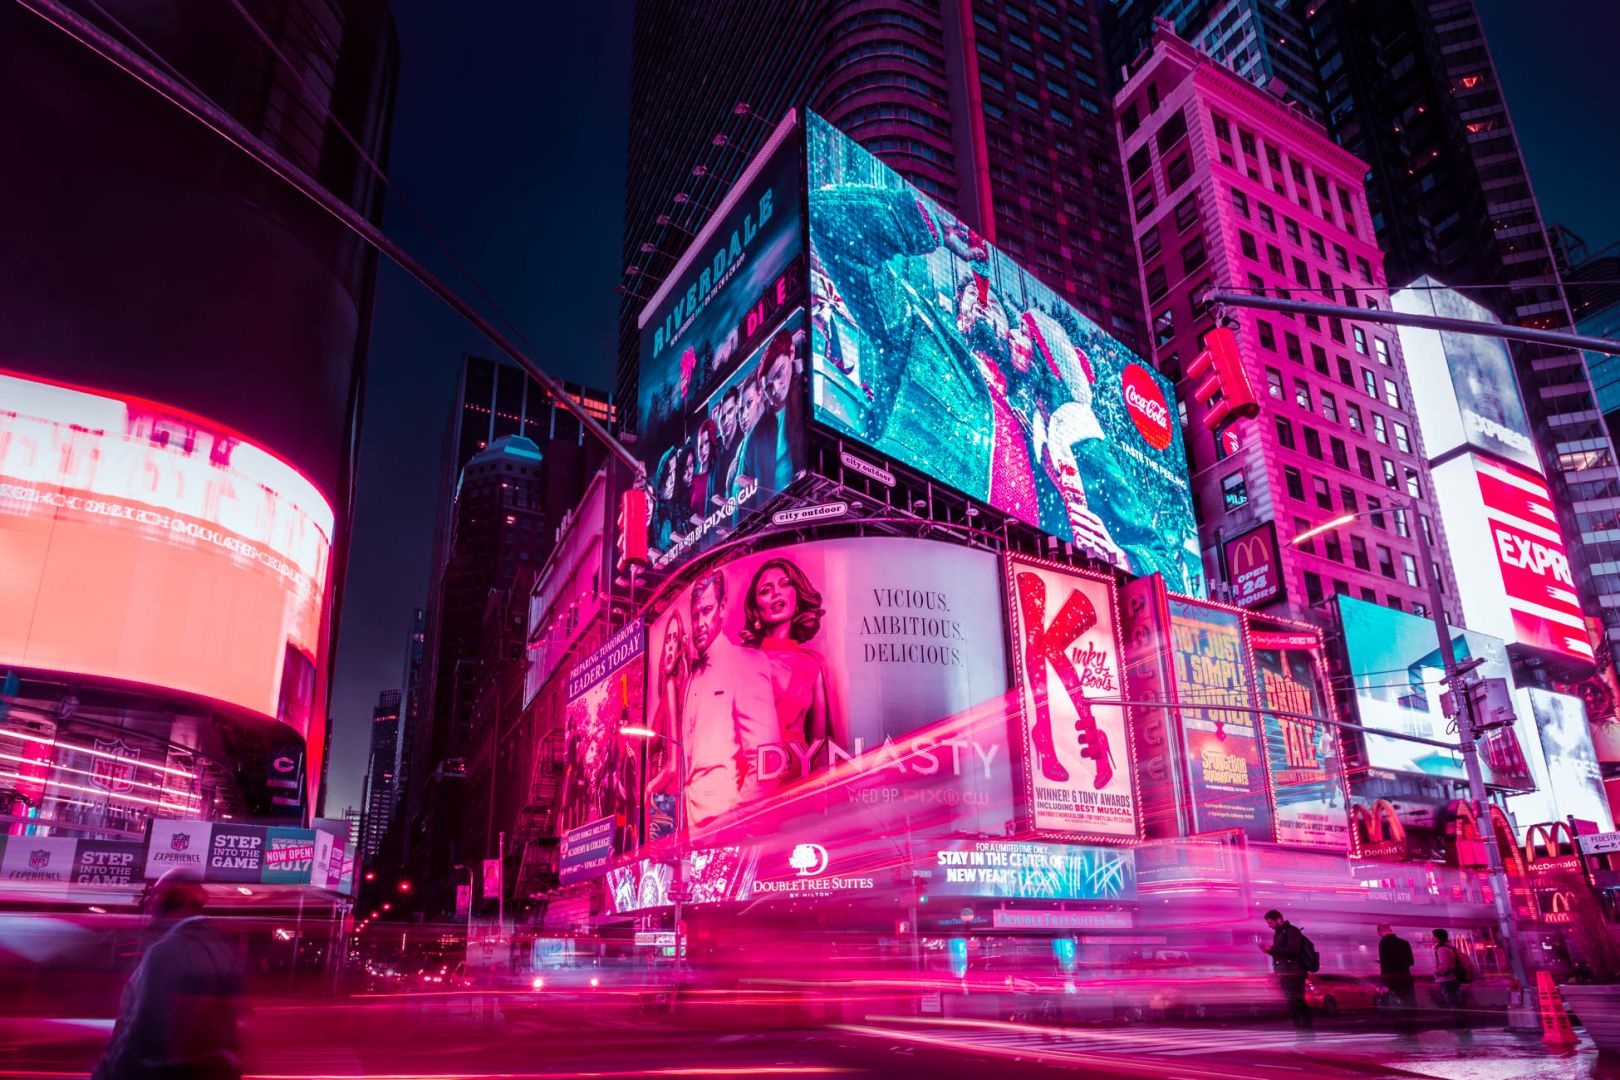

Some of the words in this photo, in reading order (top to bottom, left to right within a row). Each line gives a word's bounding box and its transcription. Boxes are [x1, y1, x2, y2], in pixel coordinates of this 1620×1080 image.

[653, 188, 774, 358] RIVERDALE
[1125, 384, 1168, 430] Coca-Cola
[845, 457, 861, 470] city
[862, 465, 892, 482] outdoor
[1120, 440, 1145, 464] TASTE
[1144, 455, 1160, 473] THE
[1159, 465, 1187, 491] FEELING
[780, 511, 800, 522] city
[801, 504, 843, 518] outdoor
[1237, 564, 1269, 584] OPEN
[1243, 574, 1268, 596] 24
[873, 588, 951, 612] VICIOUS.
[1237, 585, 1277, 607] HOURS
[859, 616, 965, 641] AMBITIOUS.
[569, 651, 600, 680] PREPARING
[600, 617, 641, 658] TOMORROW'S
[863, 643, 965, 668] DELICIOUS.
[1203, 631, 1241, 664] JUST
[569, 659, 606, 699] LEADERS
[607, 632, 641, 671] TODAY
[1190, 655, 1247, 690] SIMPLE
[1081, 667, 1118, 692] Boots
[1179, 682, 1254, 727] SPONGE
[757, 733, 1001, 782] DYNASTY
[1202, 751, 1248, 774] SPONGEBOB
[94, 760, 130, 790] NFL
[847, 788, 879, 804] WED
[882, 787, 899, 804] 9P
[1035, 787, 1071, 803] WINNER!
[1071, 789, 1078, 803] 6
[1077, 790, 1099, 805] TONY
[1100, 793, 1131, 808] AWARDS
[1037, 801, 1074, 811] INCLUDING
[1074, 804, 1095, 813] BEST
[1096, 806, 1132, 816] MUSICAL
[172, 839, 188, 849] NFL
[214, 834, 262, 849] STEP
[590, 837, 609, 850] COLLEGE
[976, 842, 990, 852] FOR
[995, 844, 1020, 853] LIMITED
[1019, 844, 1032, 854] TIME
[31, 857, 48, 867] NFL
[81, 851, 134, 867] STEP
[153, 852, 201, 863] EXPERIENCE
[211, 856, 259, 869] GAME
[213, 848, 239, 856] INTO
[239, 849, 260, 858] THE
[266, 850, 287, 862] NOW
[288, 847, 314, 860] OPEN!
[937, 851, 969, 866] STAY
[970, 852, 984, 866] IN
[985, 852, 1008, 867] THE
[1009, 853, 1049, 869] CENTER
[1049, 854, 1065, 868] OF
[79, 865, 108, 875] INTO
[108, 866, 132, 876] THE
[268, 859, 313, 871] 2017
[8, 870, 61, 881] EXPERIENCE
[77, 874, 131, 887] GAME
[946, 868, 976, 883] NEW
[977, 868, 1016, 884] YEAR'S
